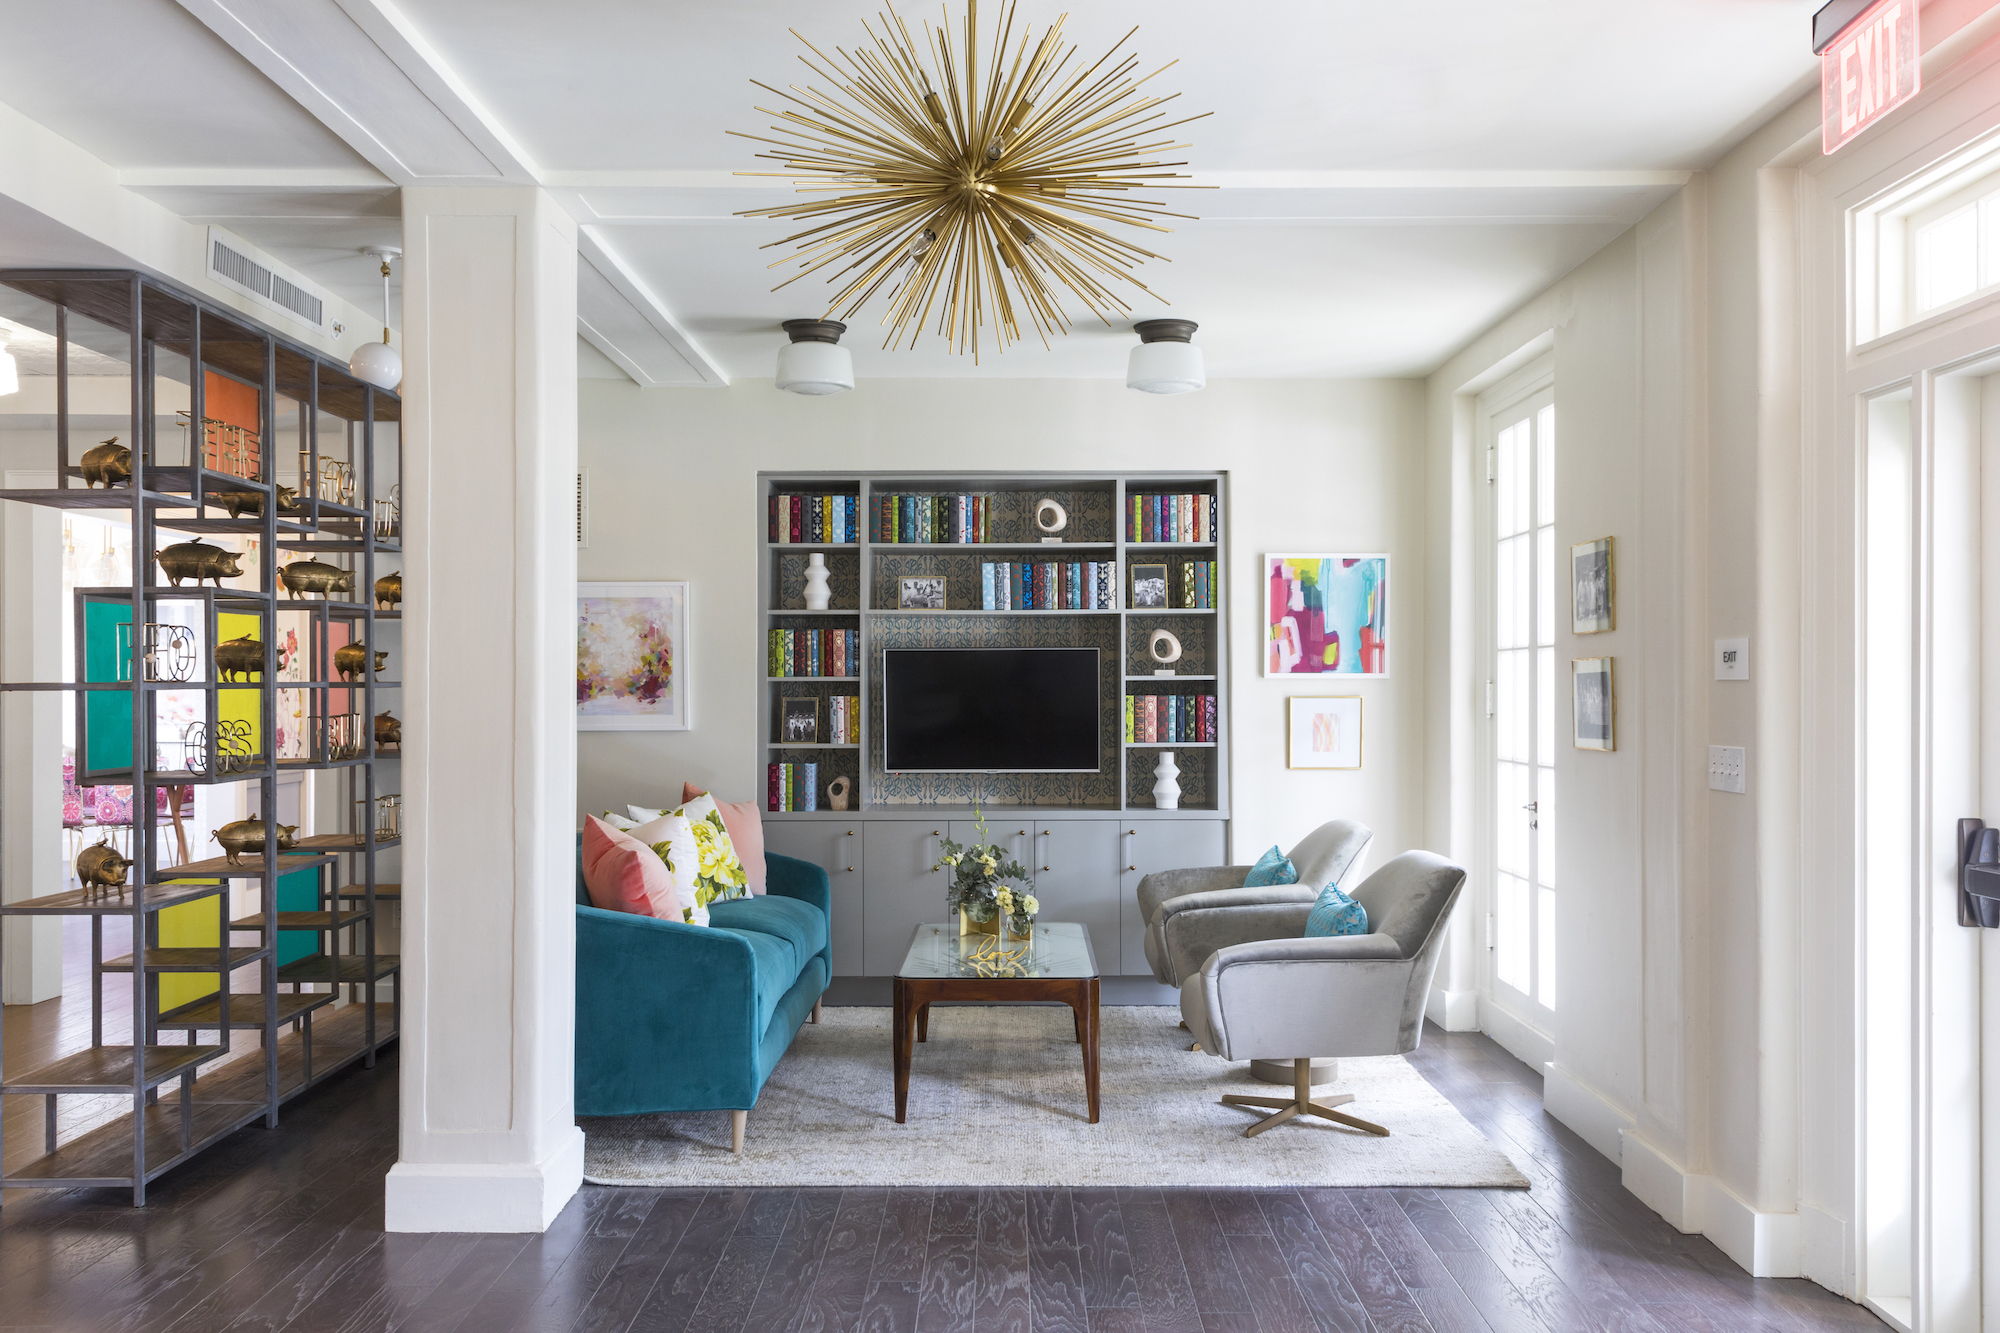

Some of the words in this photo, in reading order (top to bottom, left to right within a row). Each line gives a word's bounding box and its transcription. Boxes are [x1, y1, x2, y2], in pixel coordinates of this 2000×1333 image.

[1840, 2, 1902, 135] EXIT
[1722, 650, 1737, 663] EXIT
[967, 934, 1028, 961] love
